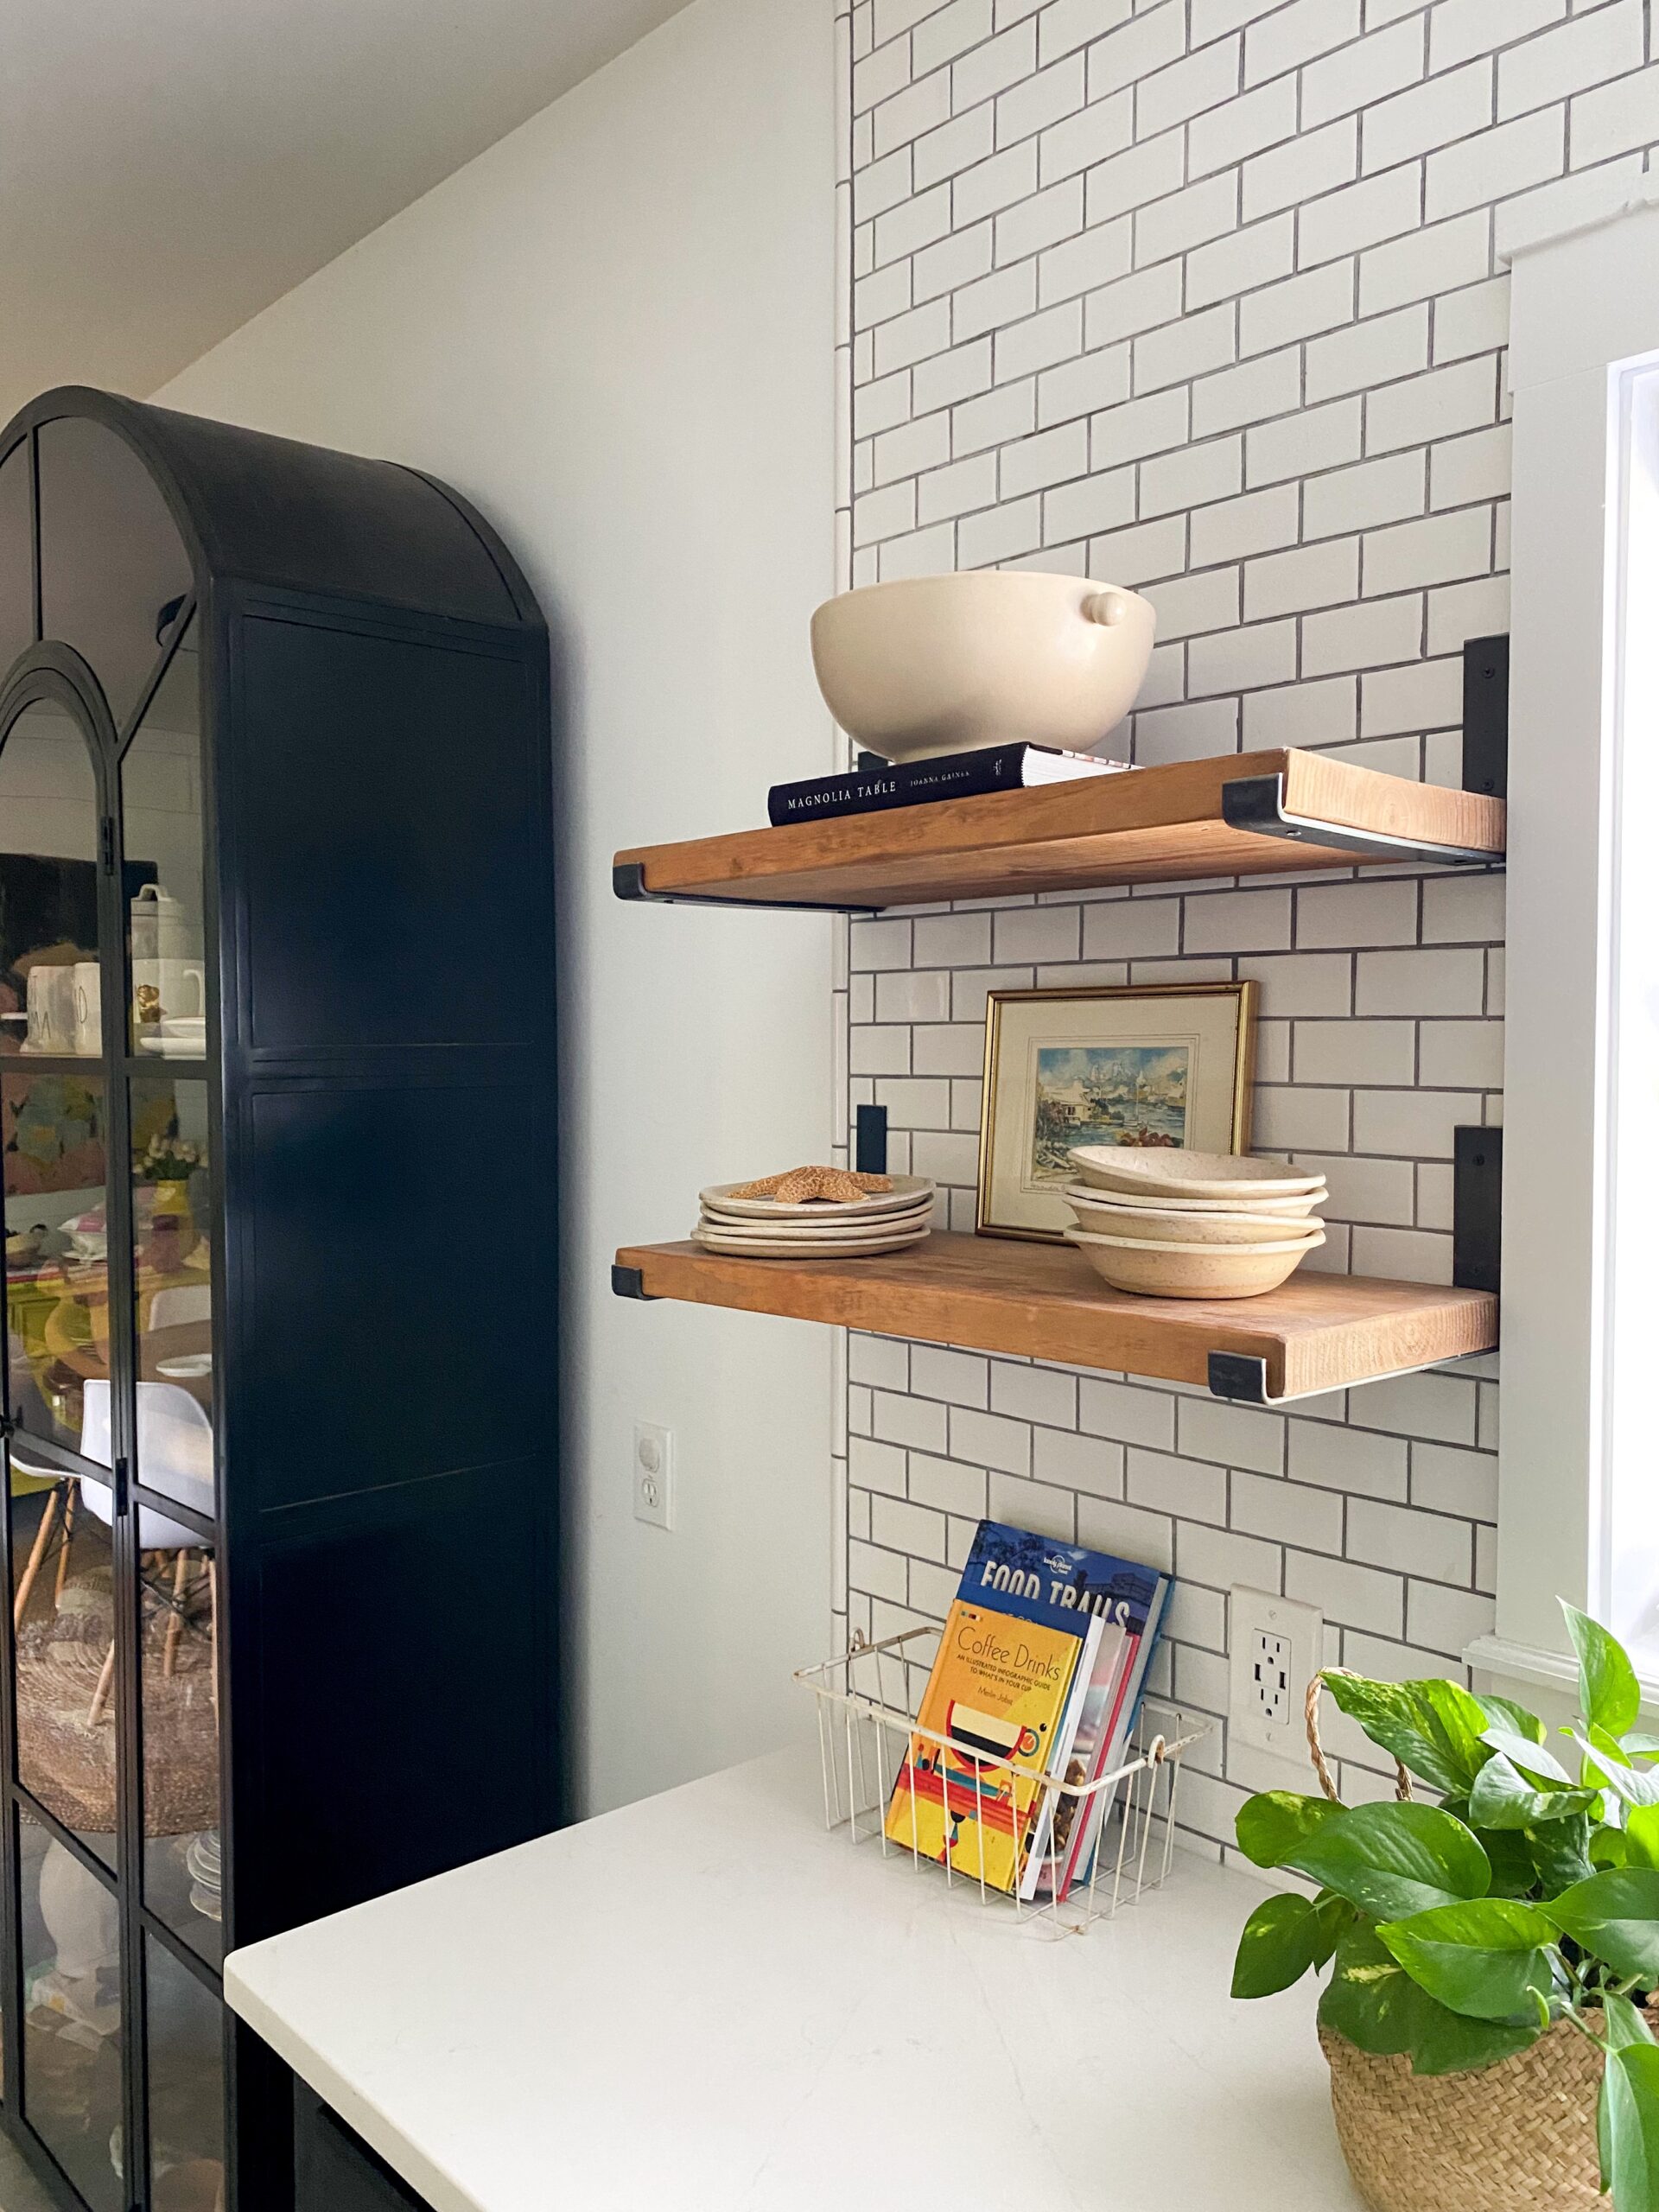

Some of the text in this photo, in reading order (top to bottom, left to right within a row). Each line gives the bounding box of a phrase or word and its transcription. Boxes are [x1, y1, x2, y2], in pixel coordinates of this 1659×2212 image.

[787, 781, 896, 810] MAGNOLIA TABLE
[980, 1560, 1040, 1599] FOOD
[958, 1626, 1060, 1681] Coffee Drinks
[966, 1658, 996, 1672] ILLUSTRATED
[998, 1669, 1033, 1684] INFOGRAPHIC
[1033, 1680, 1052, 1691] GUIDE
[969, 1666, 978, 1675] TO
[1006, 1679, 1020, 1690] YOUR
[1020, 1684, 1033, 1693] CUP
